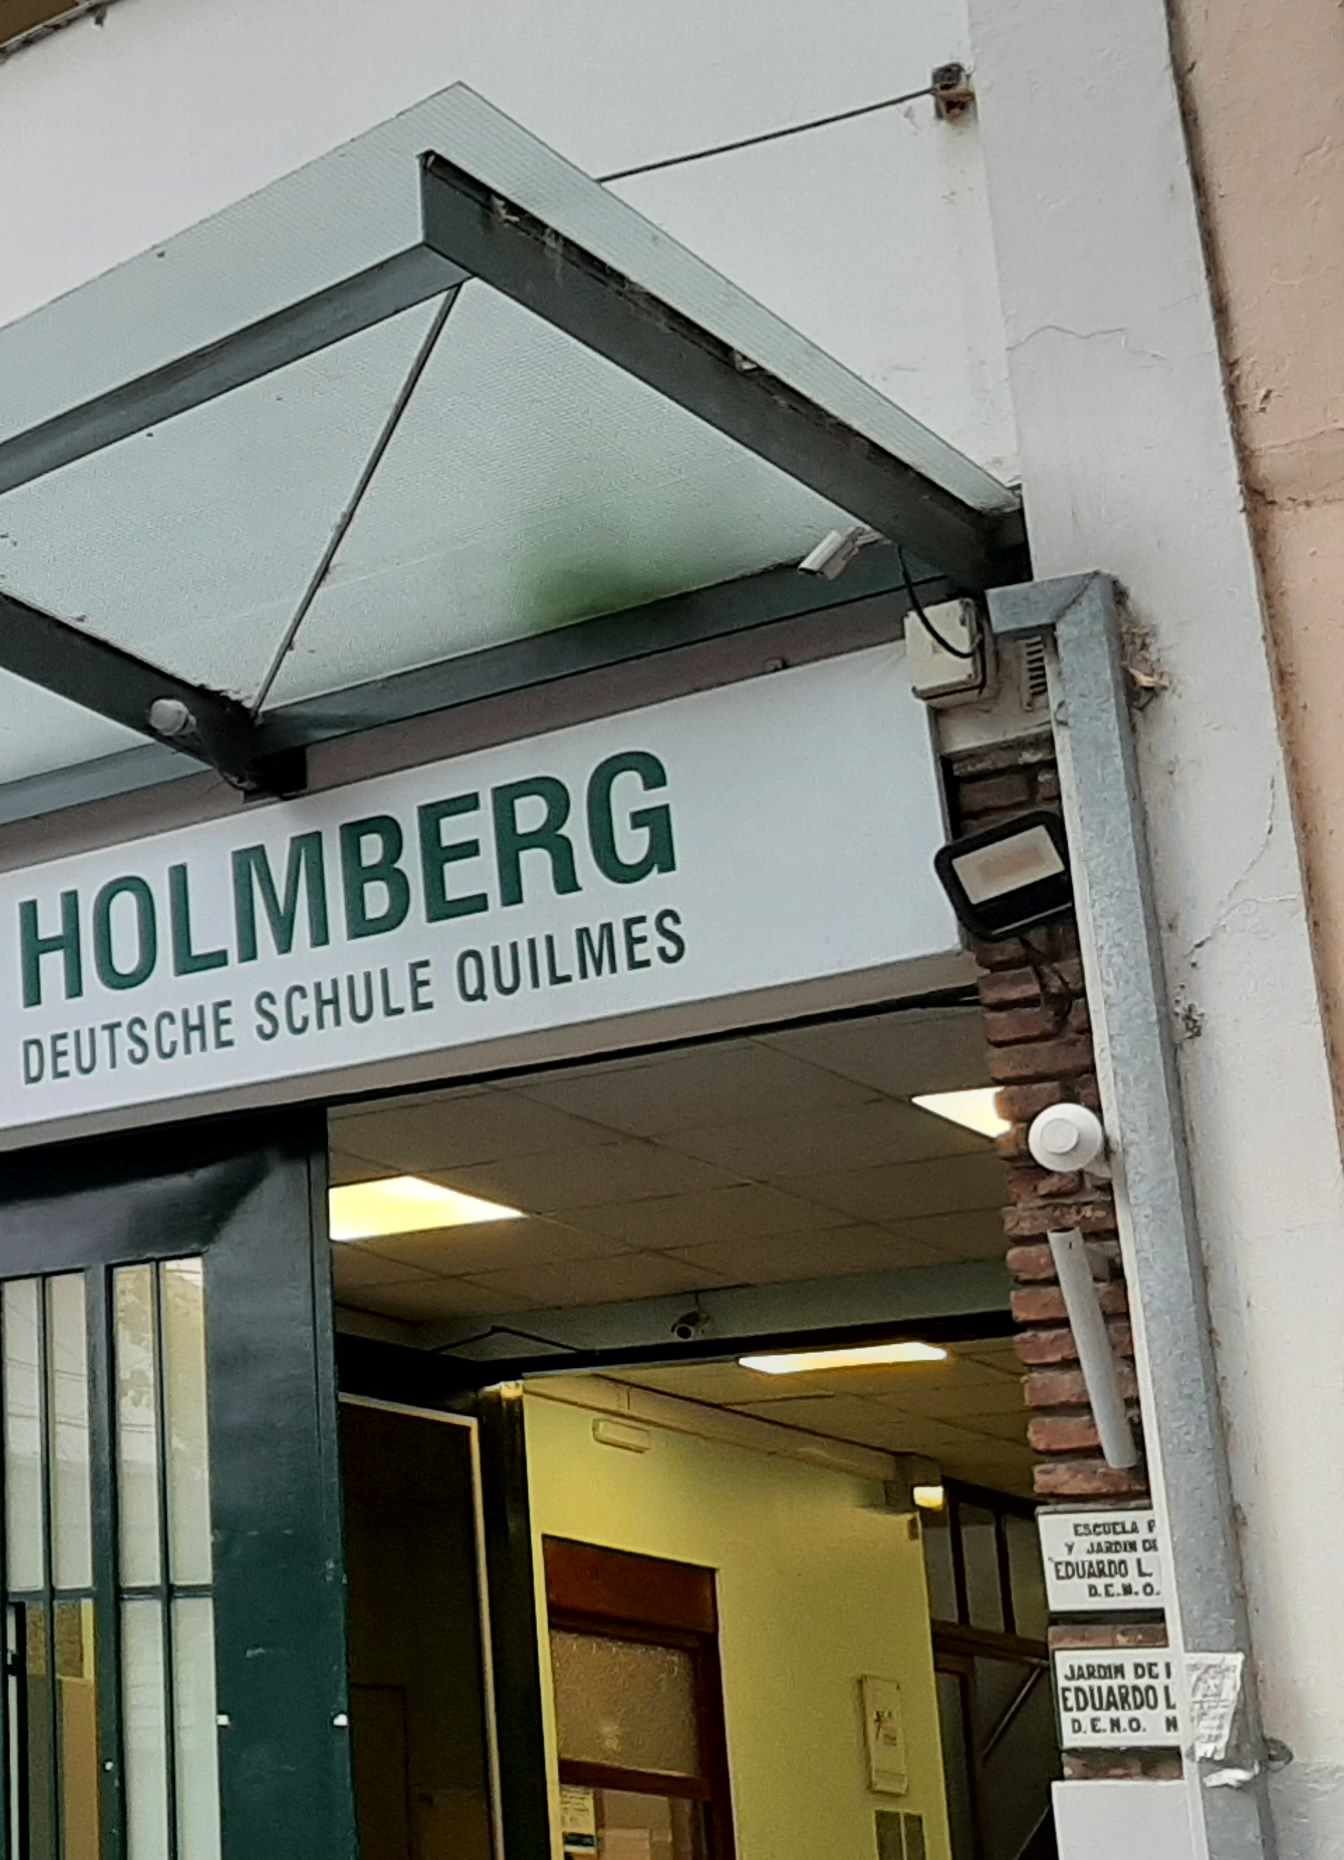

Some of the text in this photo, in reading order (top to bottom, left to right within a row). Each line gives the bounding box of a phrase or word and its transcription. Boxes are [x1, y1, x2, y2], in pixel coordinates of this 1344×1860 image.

[18, 750, 677, 1009] HOLMBERG
[22, 908, 686, 1085] DEUTSCHE SCHULE QUILMES
[1073, 1521, 1139, 1536] ESCUELA
[1064, 1541, 1074, 1555] Y
[1087, 1540, 1137, 1554] JARDIN
[1064, 1663, 1125, 1680] JARDIN
[1134, 1662, 1159, 1679] DE
[1061, 1684, 1158, 1712] EDUARDO
